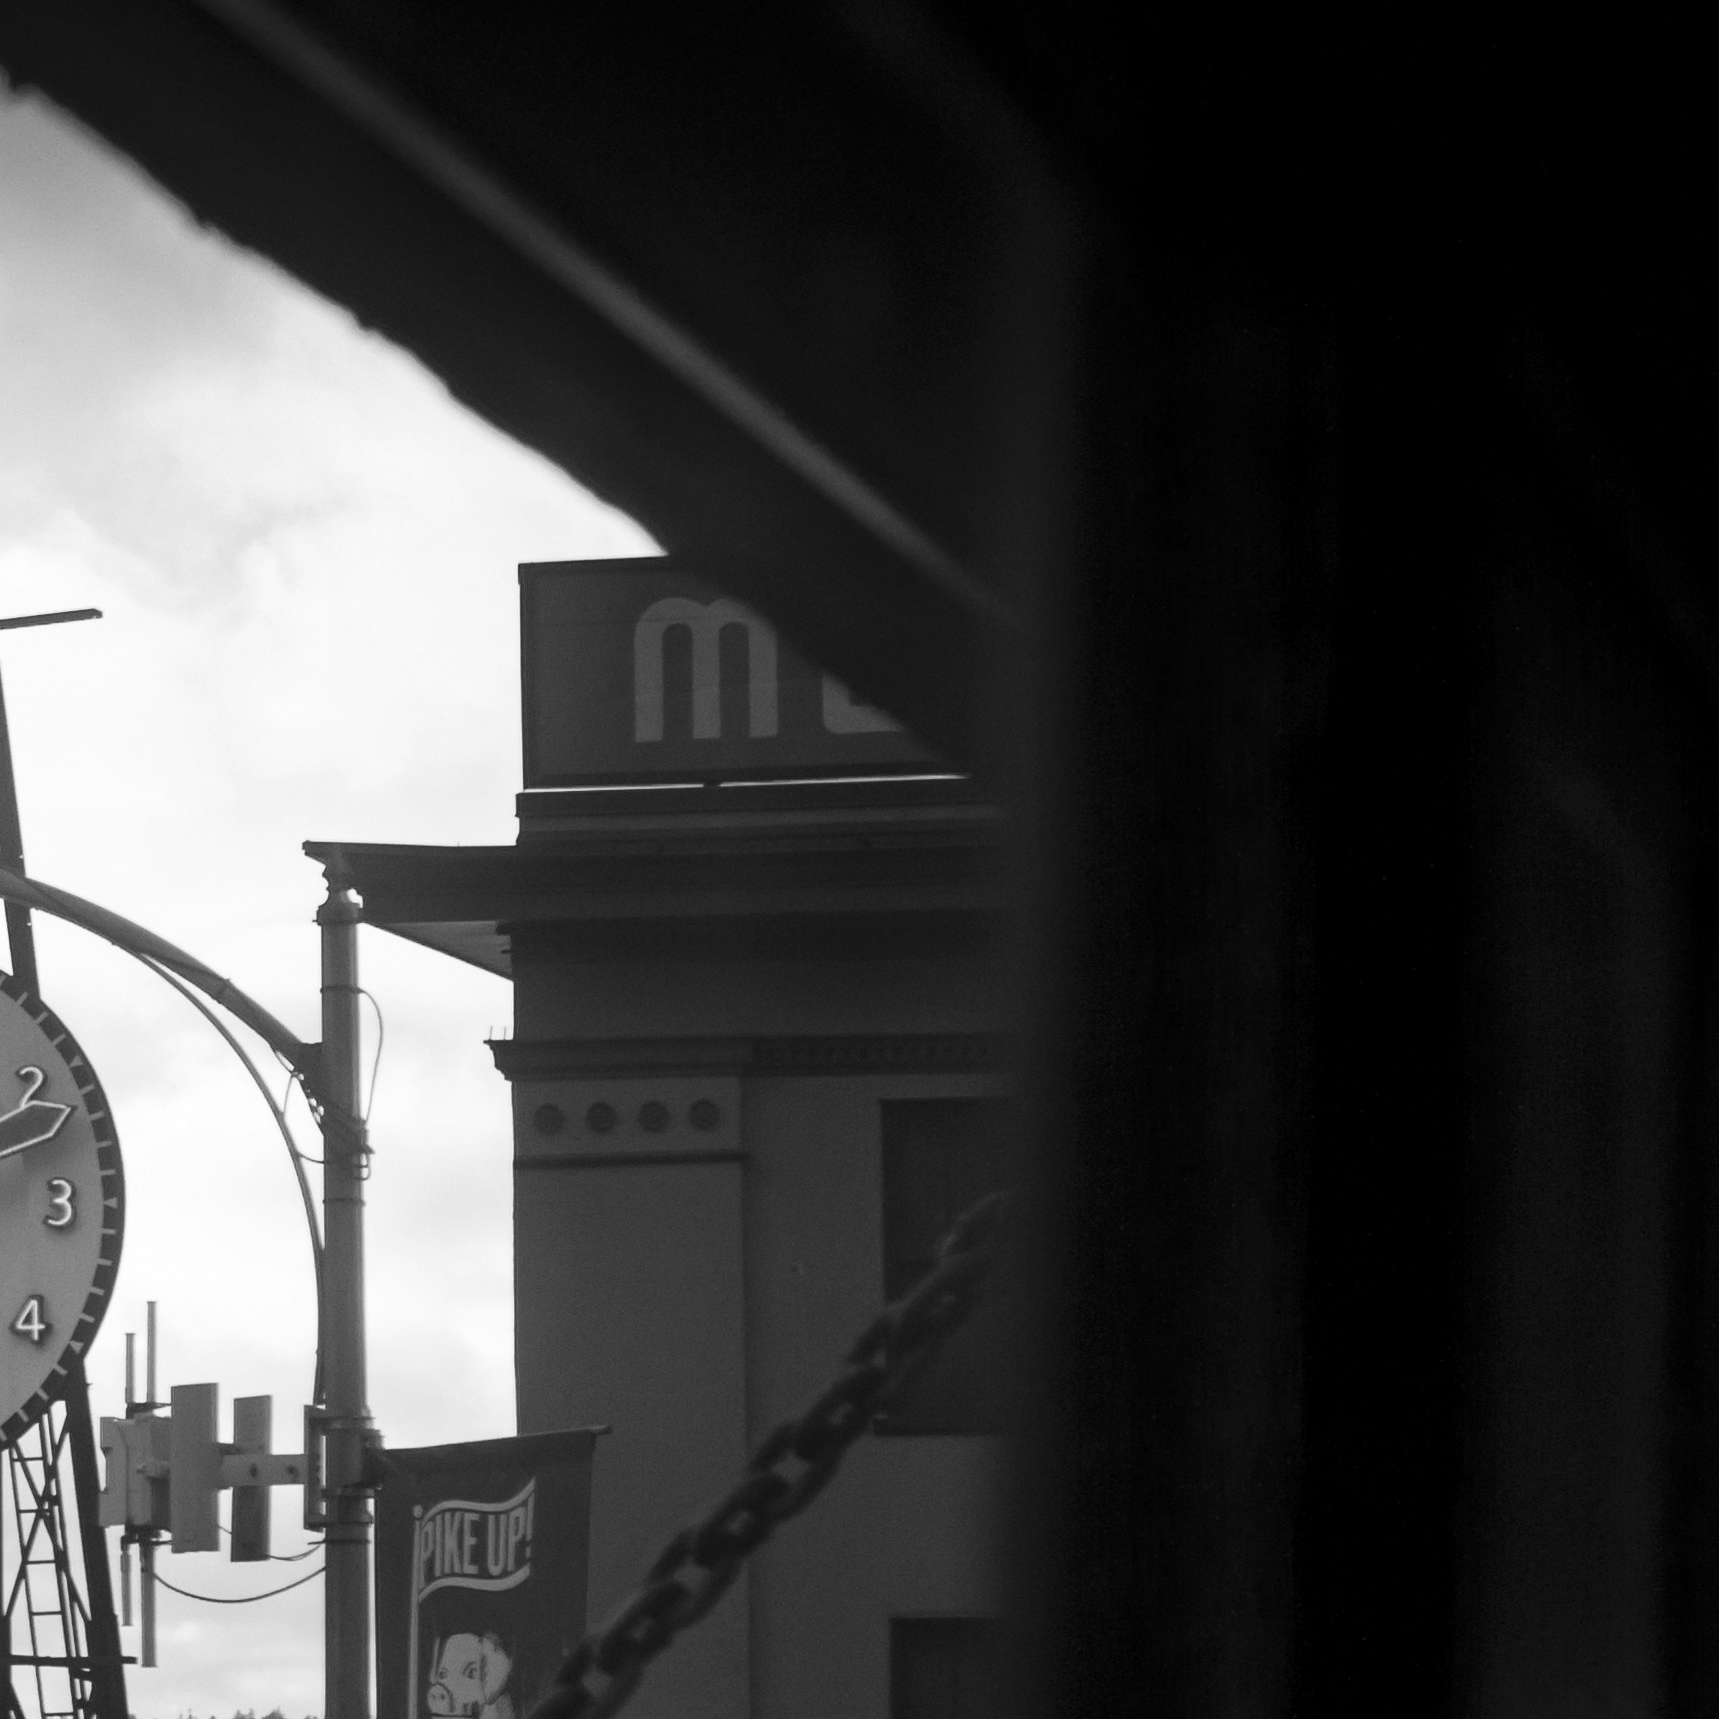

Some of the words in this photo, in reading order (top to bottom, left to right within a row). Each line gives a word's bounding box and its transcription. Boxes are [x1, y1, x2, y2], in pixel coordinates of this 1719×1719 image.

[634, 597, 904, 742] m
[15, 1065, 47, 1108] 2
[45, 1178, 76, 1227] 3
[11, 1295, 50, 1343] 4
[420, 1511, 481, 1587] PIKE
[487, 1493, 535, 1576] UP!
